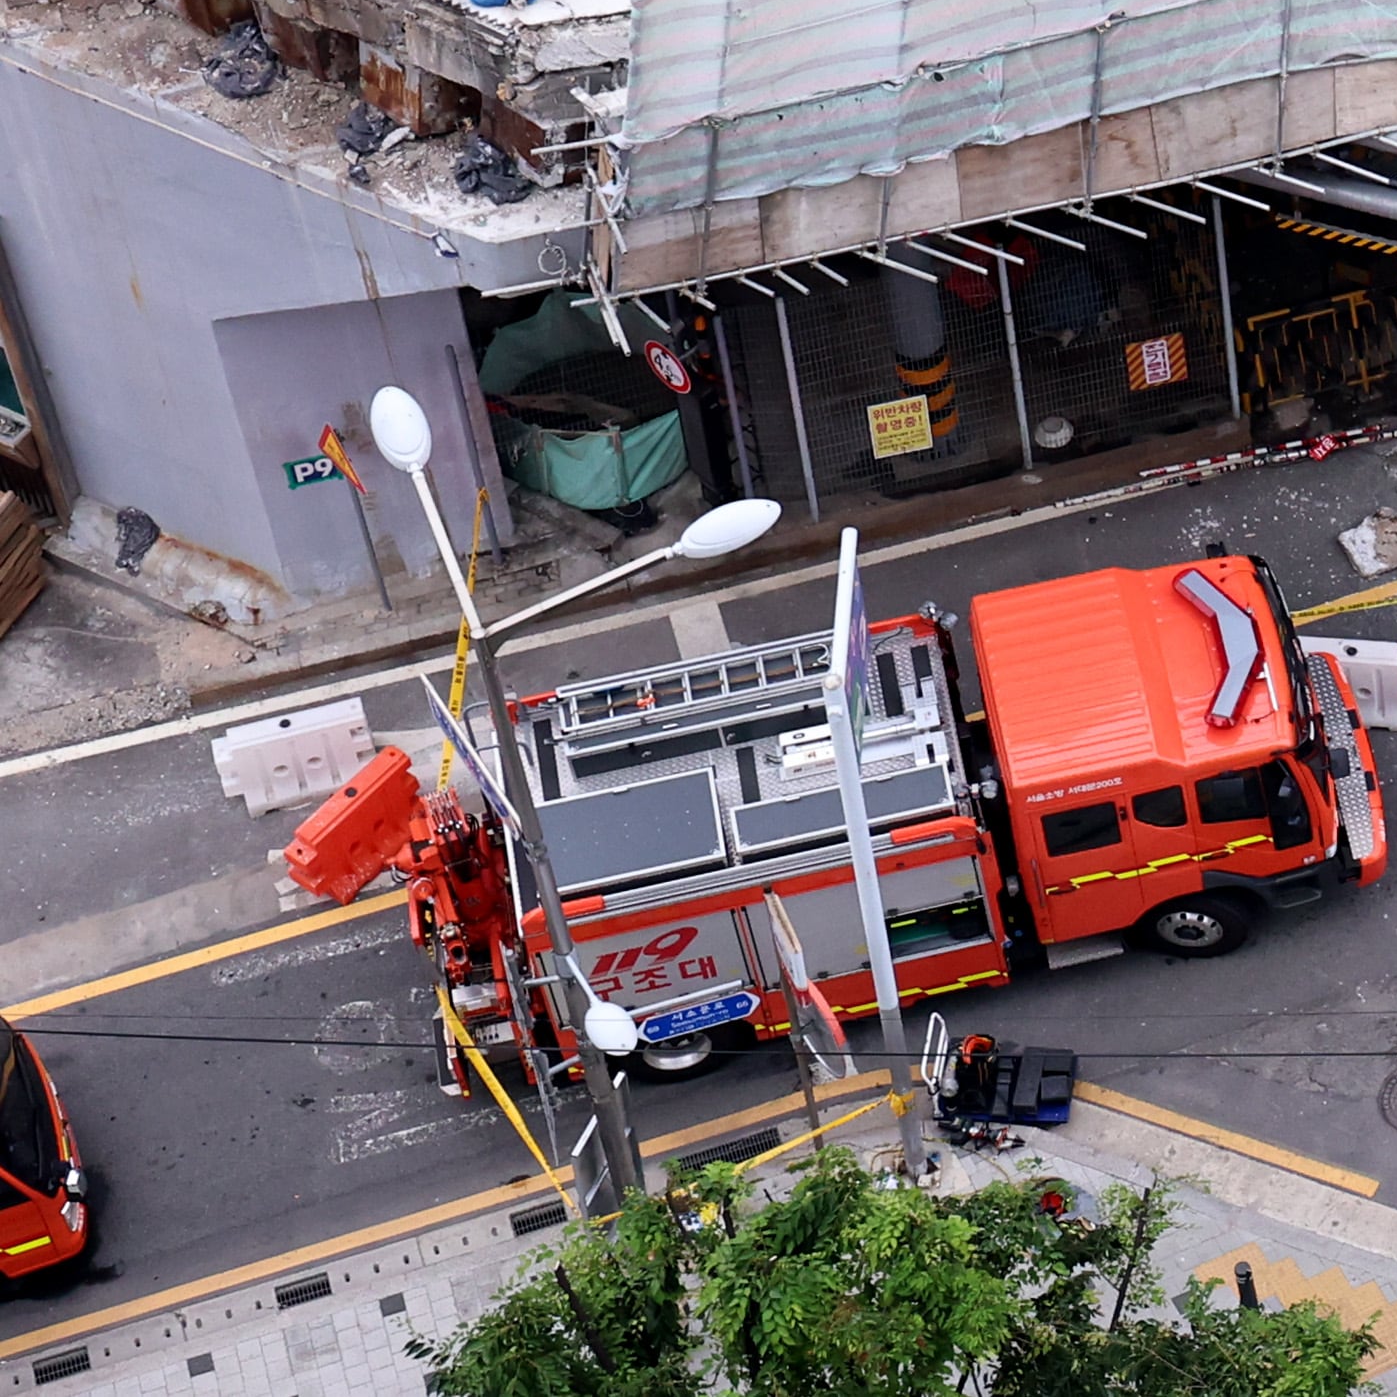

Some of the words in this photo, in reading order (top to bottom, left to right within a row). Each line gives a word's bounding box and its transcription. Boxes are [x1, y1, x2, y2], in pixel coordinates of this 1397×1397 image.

[872, 401, 922, 421] 위반차량
[294, 457, 334, 483] P9
[1026, 788, 1064, 803] 서울소방
[1067, 777, 1123, 795] 서대문200호
[591, 926, 699, 978] 119
[590, 955, 718, 1002] 구조대
[671, 1001, 726, 1021] 서소문로
